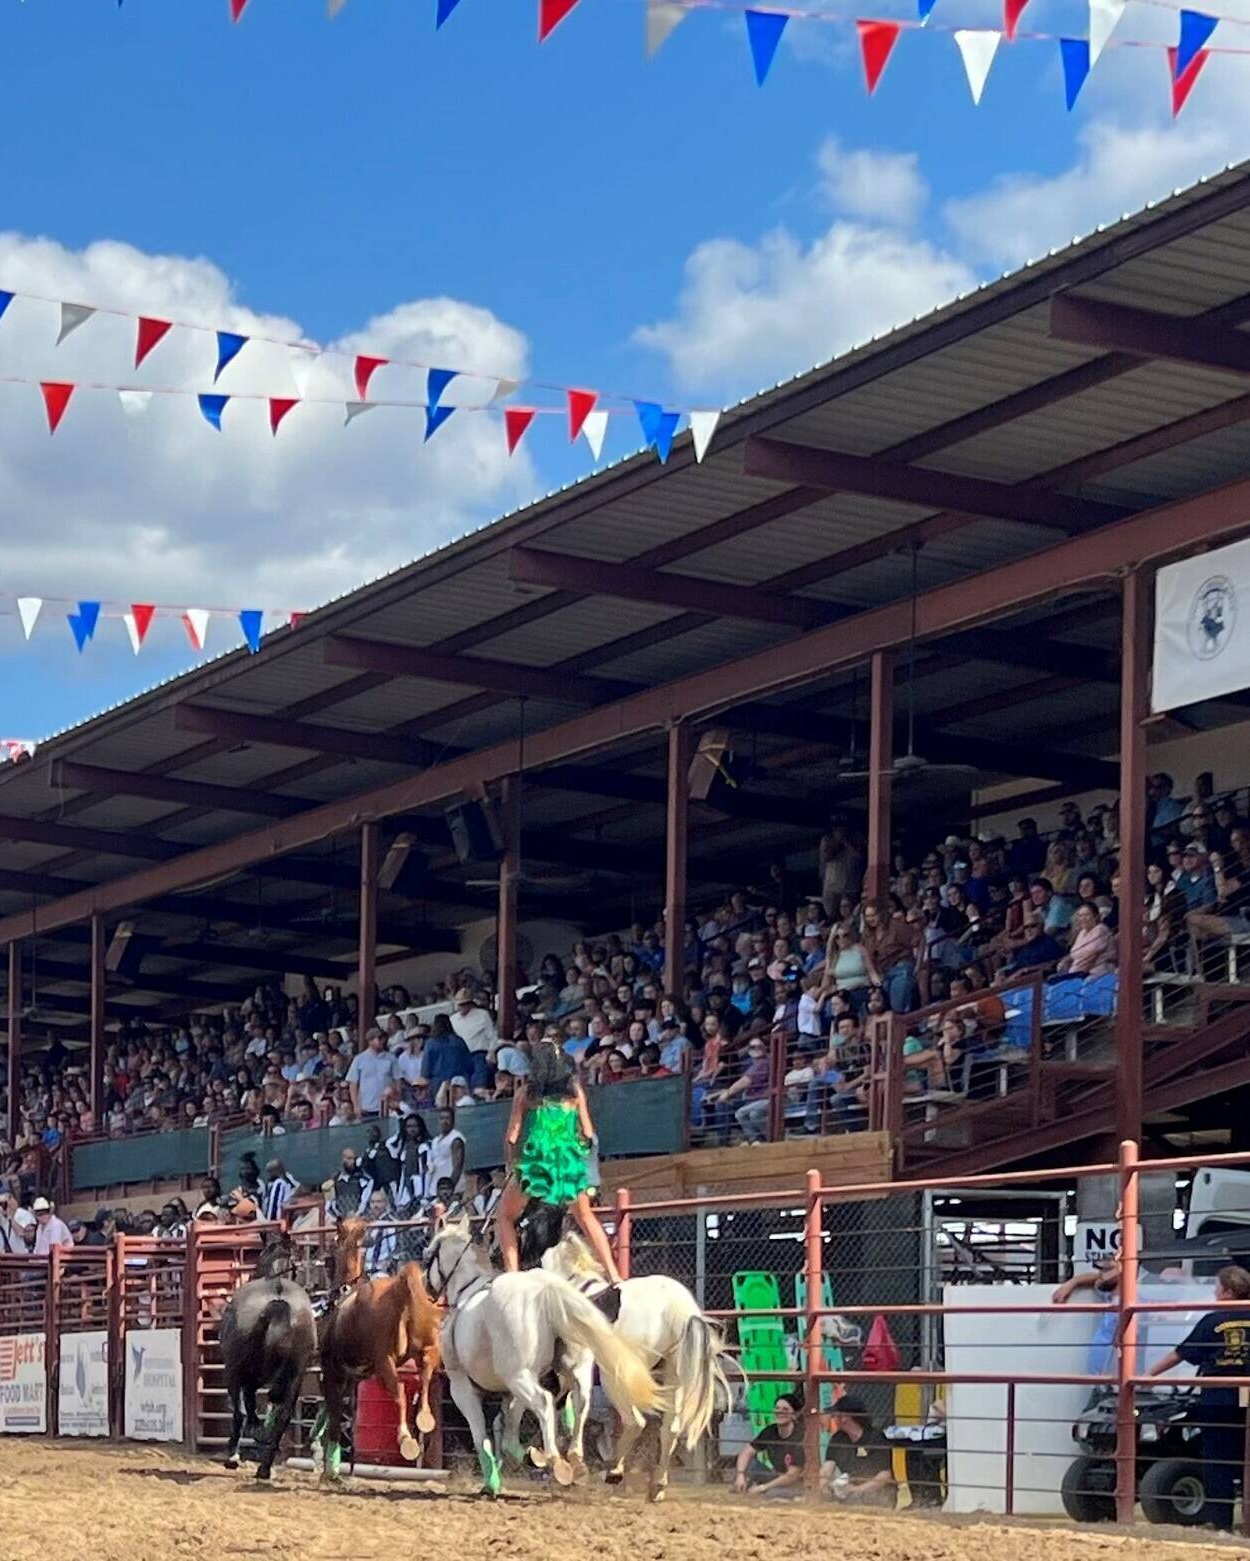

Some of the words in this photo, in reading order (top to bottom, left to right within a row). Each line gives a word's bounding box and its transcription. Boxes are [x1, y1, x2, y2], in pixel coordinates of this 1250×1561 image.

[1086, 1228, 1125, 1250] NO
[0, 1384, 21, 1403] FOOD
[22, 1382, 44, 1402] MART
